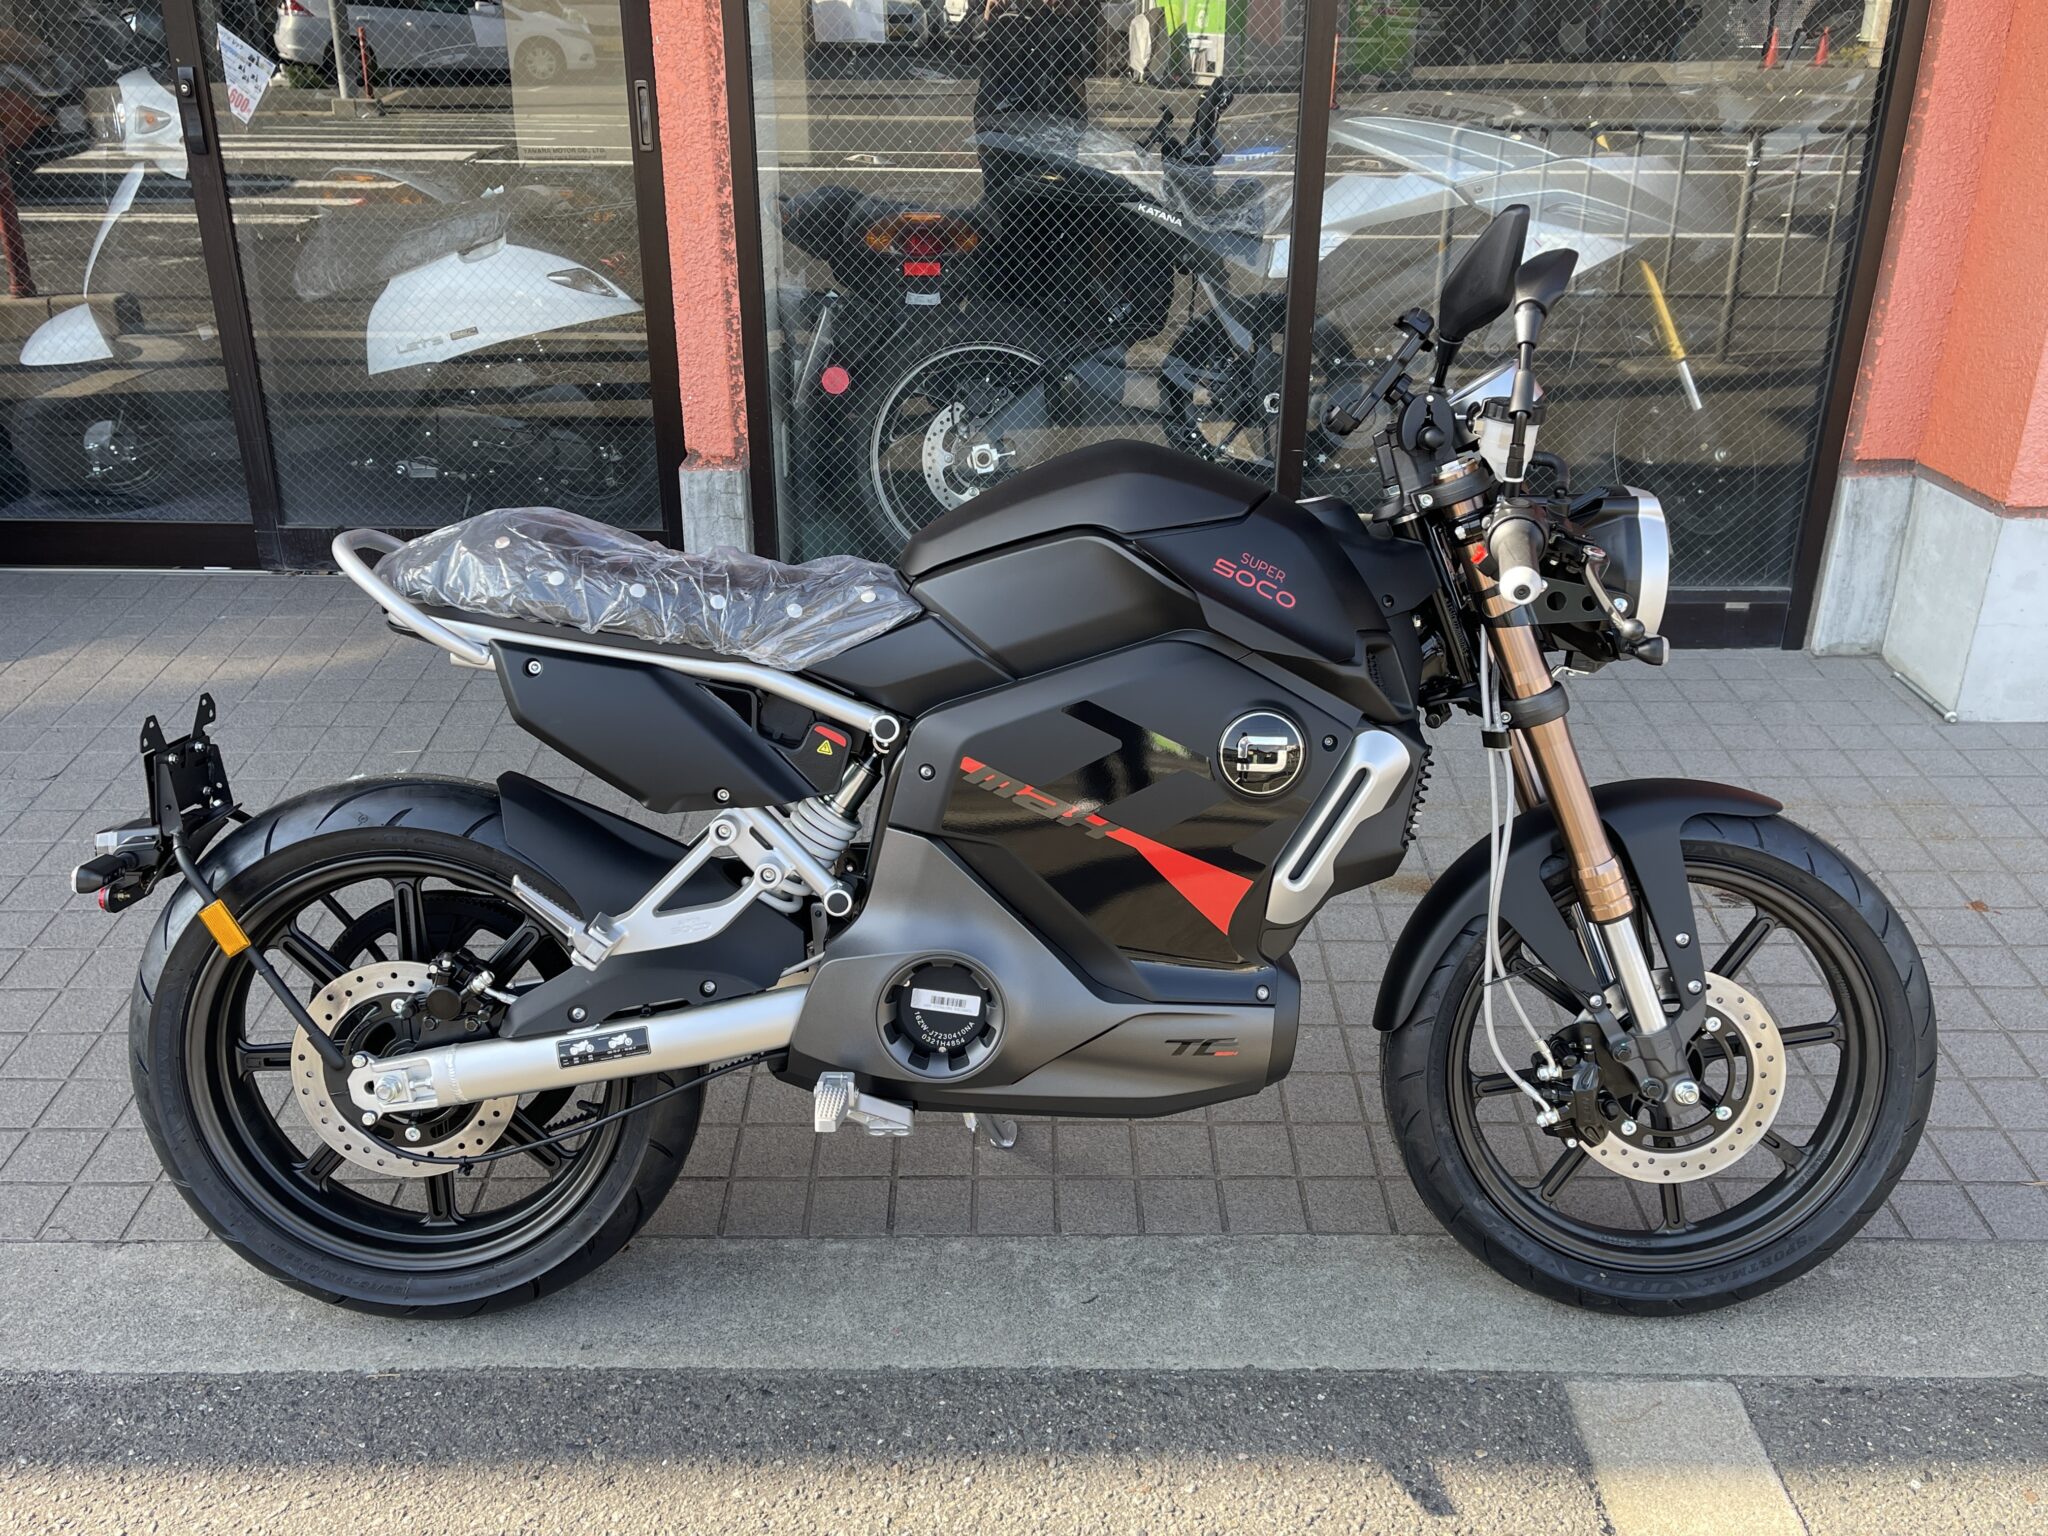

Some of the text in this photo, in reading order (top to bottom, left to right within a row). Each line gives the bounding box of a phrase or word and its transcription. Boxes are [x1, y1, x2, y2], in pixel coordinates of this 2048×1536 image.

[1138, 203, 1182, 227] KATANA
[1212, 558, 1296, 608] SOCO
[1240, 552, 1286, 583] SUPER
[1701, 1235, 1812, 1288] SPORTMAX
